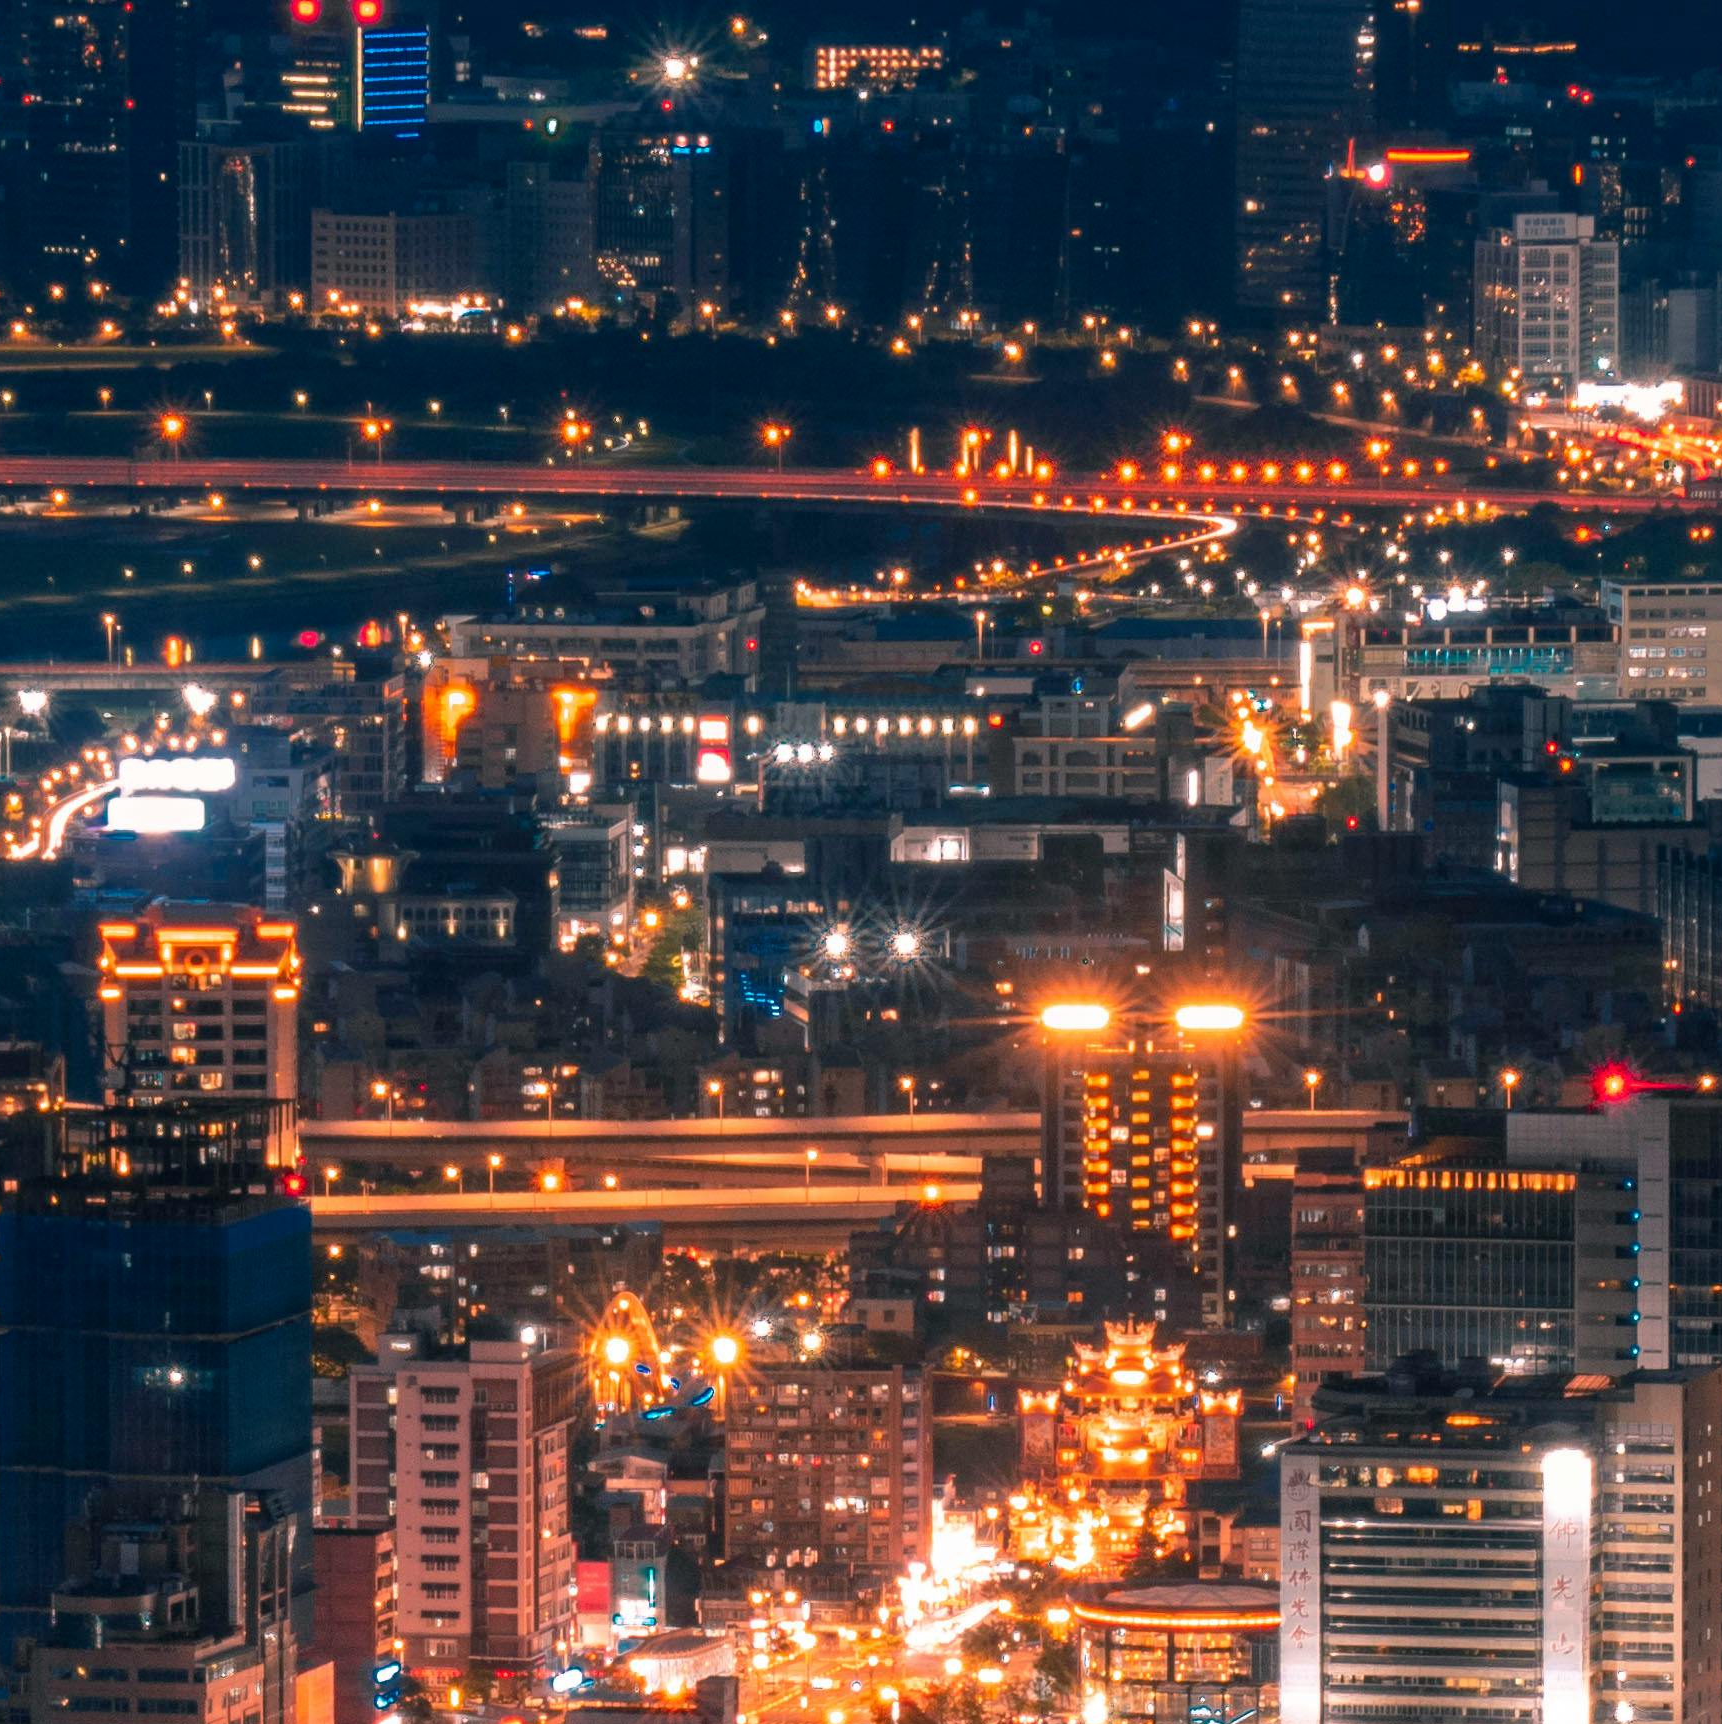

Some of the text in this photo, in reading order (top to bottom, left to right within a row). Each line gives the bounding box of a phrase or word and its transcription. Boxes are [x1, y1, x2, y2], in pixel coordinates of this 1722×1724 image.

[1288, 1509, 1311, 1649] 國際佛光會
[1548, 1518, 1577, 1655] 佛光山
